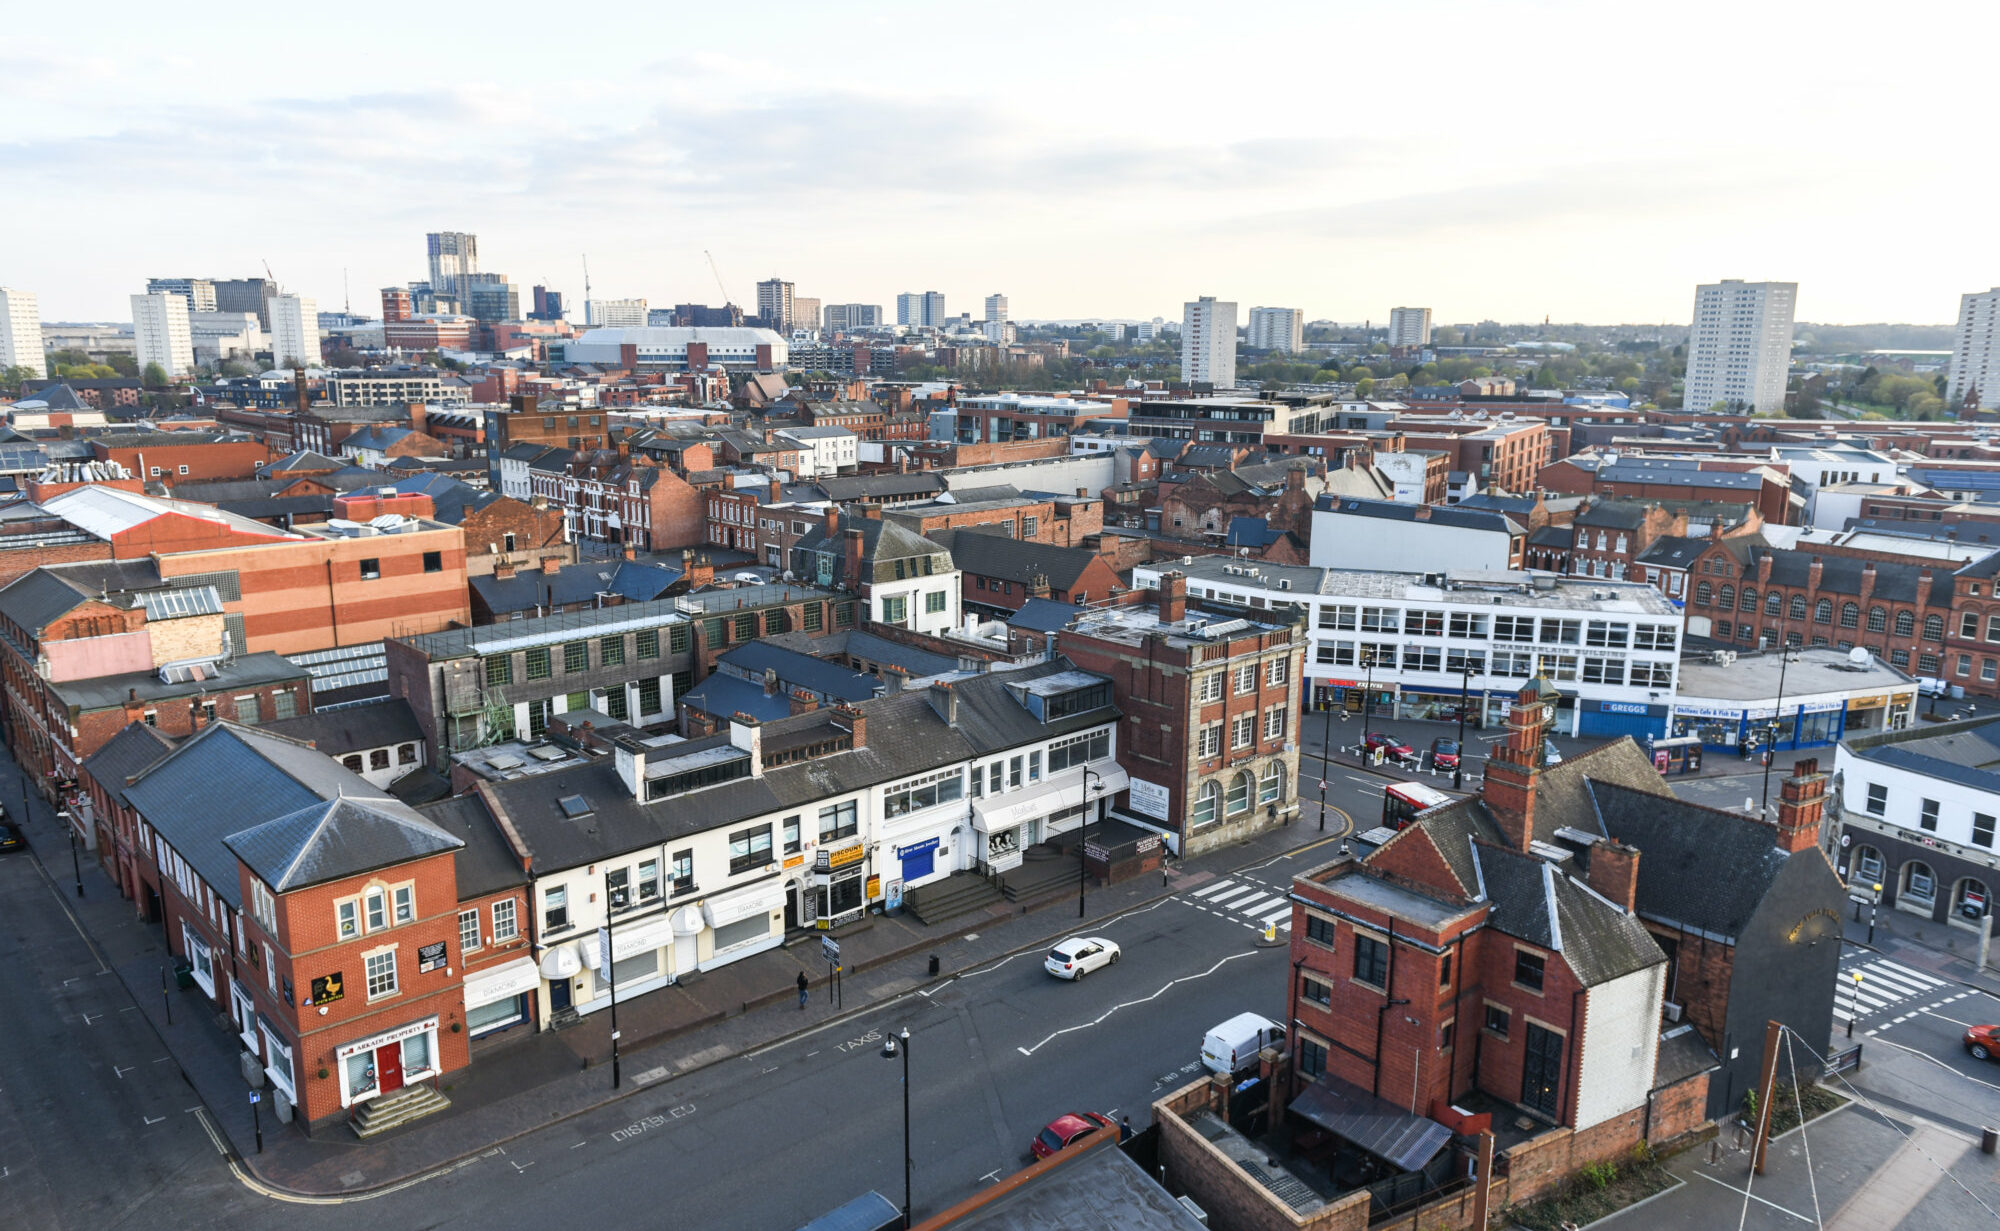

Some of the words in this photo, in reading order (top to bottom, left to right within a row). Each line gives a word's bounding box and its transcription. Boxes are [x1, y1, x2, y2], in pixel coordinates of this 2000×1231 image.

[1492, 643, 1569, 655] CHAMBERLAIN
[1575, 649, 1627, 658] BUILDING
[1328, 679, 1356, 687] TESCO
[1611, 704, 1646, 714] GREGGS
[830, 844, 862, 858] DISCOUNT
[356, 1038, 384, 1051] ARKADE
[386, 1026, 421, 1041] PROPERTY
[833, 1031, 882, 1053] TAXIS
[611, 1104, 697, 1142] DISABLED
